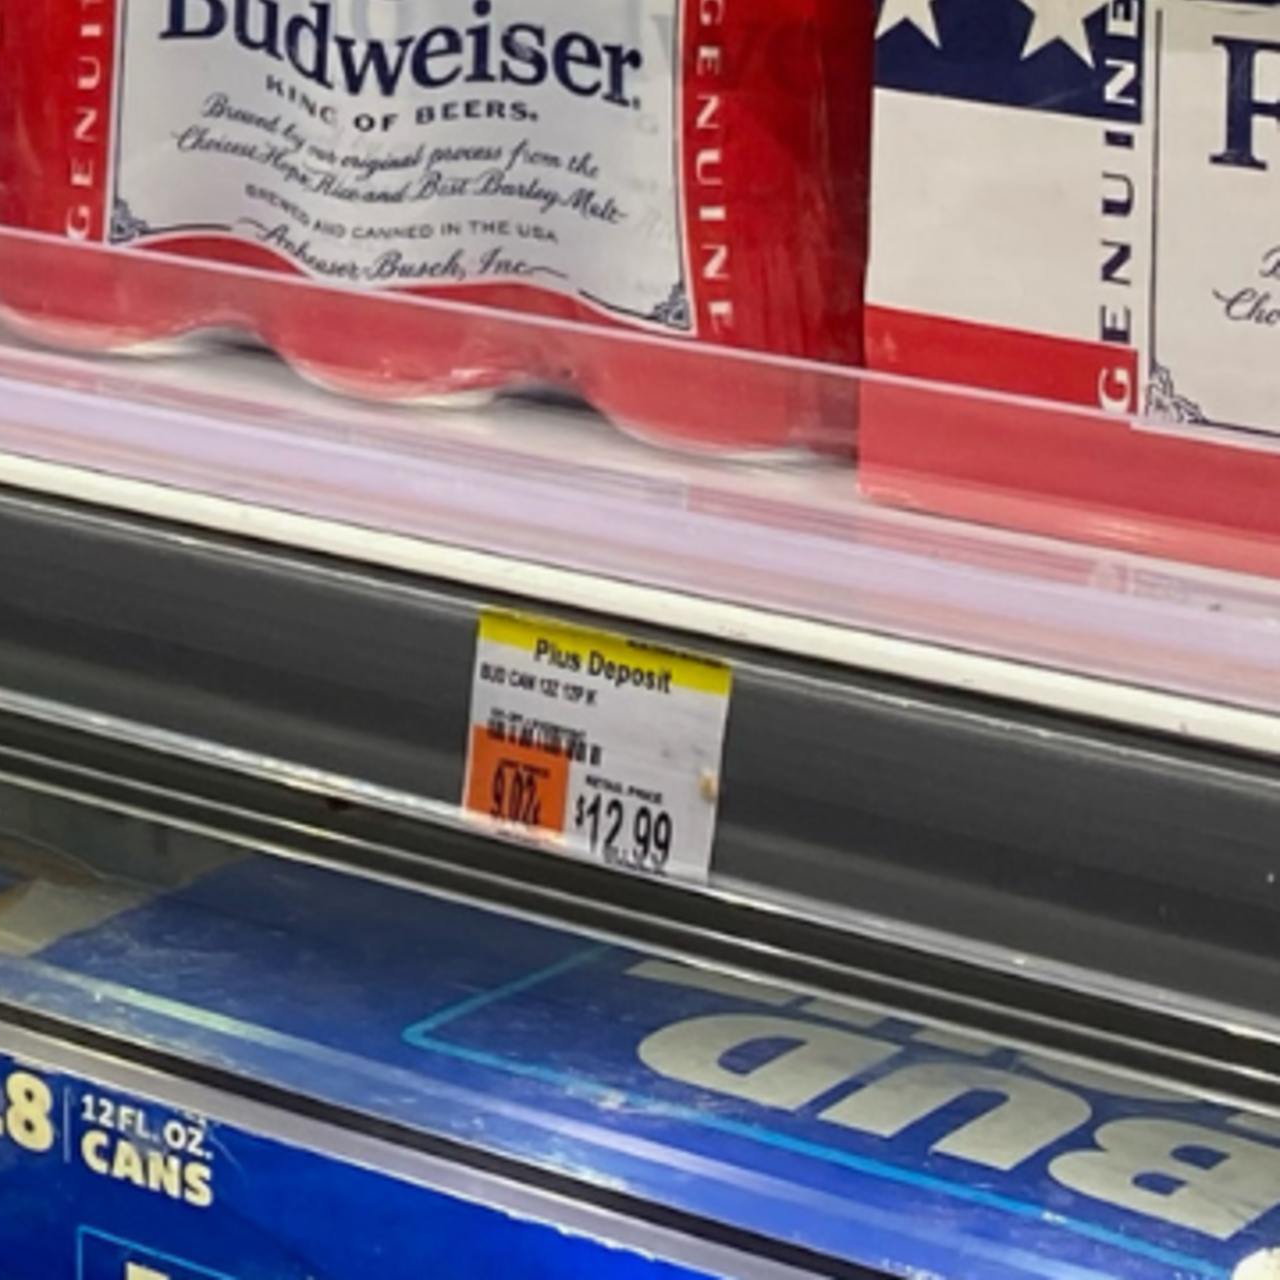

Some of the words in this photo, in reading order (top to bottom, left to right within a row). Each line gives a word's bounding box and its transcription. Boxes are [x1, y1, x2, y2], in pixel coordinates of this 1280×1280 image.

[265, 73, 339, 124] KING
[353, 112, 399, 133] OF
[200, 92, 281, 134] Brewed
[340, 140, 427, 182] original
[424, 145, 502, 172] process
[504, 139, 562, 172] from
[565, 151, 600, 180] the
[361, 180, 412, 204] and
[474, 168, 559, 215] Barley
[561, 187, 628, 224] Malt
[351, 223, 434, 240] CANNED
[440, 221, 460, 236] IN
[469, 220, 510, 236] THE
[533, 637, 581, 673] Plus
[588, 649, 673, 695] Deposit
[575, 792, 674, 868] $12.99
[80, 1091, 113, 1130] 12
[635, 1013, 1280, 1244] BUD
[80, 1128, 215, 1210] CANS
